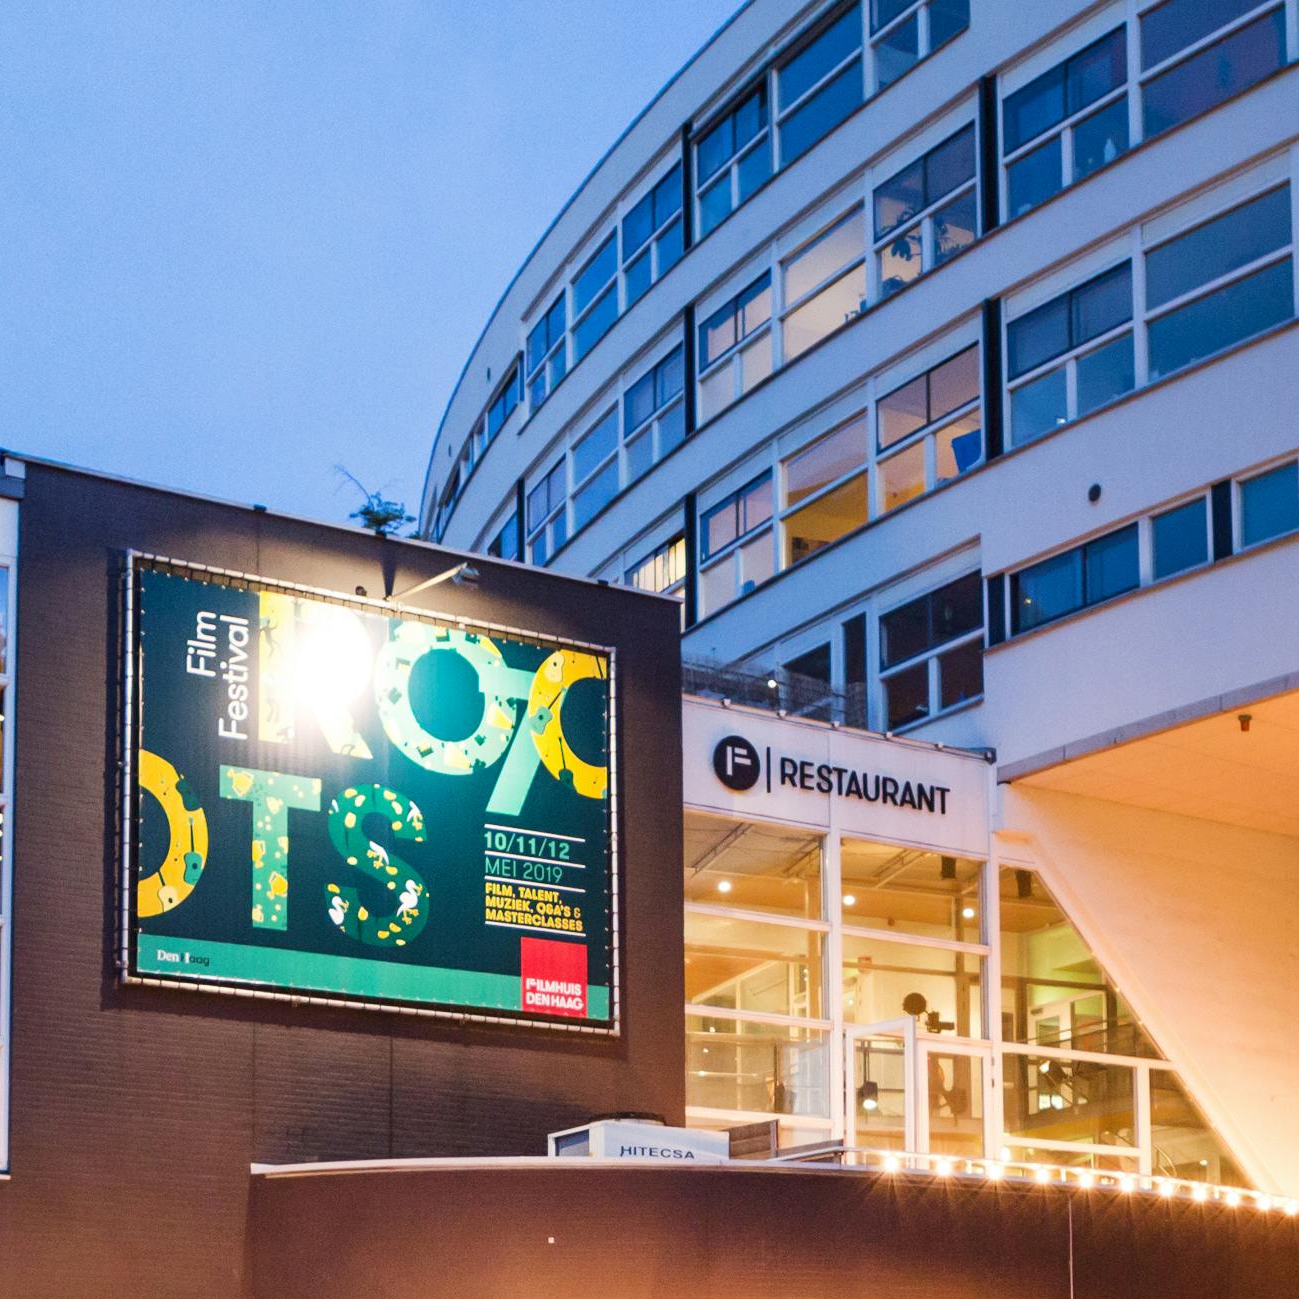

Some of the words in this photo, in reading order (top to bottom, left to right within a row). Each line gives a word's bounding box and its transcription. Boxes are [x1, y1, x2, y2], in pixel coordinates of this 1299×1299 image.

[186, 611, 217, 677] Film
[218, 615, 250, 740] Festival
[780, 756, 951, 815] RESTAURANT
[484, 830, 570, 861] 10/11/12
[485, 856, 517, 877] MEI
[523, 862, 563, 884] 2019
[485, 882, 516, 898] FILM,
[518, 886, 562, 904] TALENT,
[485, 895, 534, 913] MUZIEK,
[536, 902, 571, 918] Q&A'S
[485, 908, 583, 932] MASTERCLASSES
[157, 950, 180, 963] Den
[525, 978, 582, 996] FILMHUIS
[525, 992, 551, 1006] DEN
[551, 995, 585, 1010] HAAG
[620, 1145, 695, 1159] HITECSA
